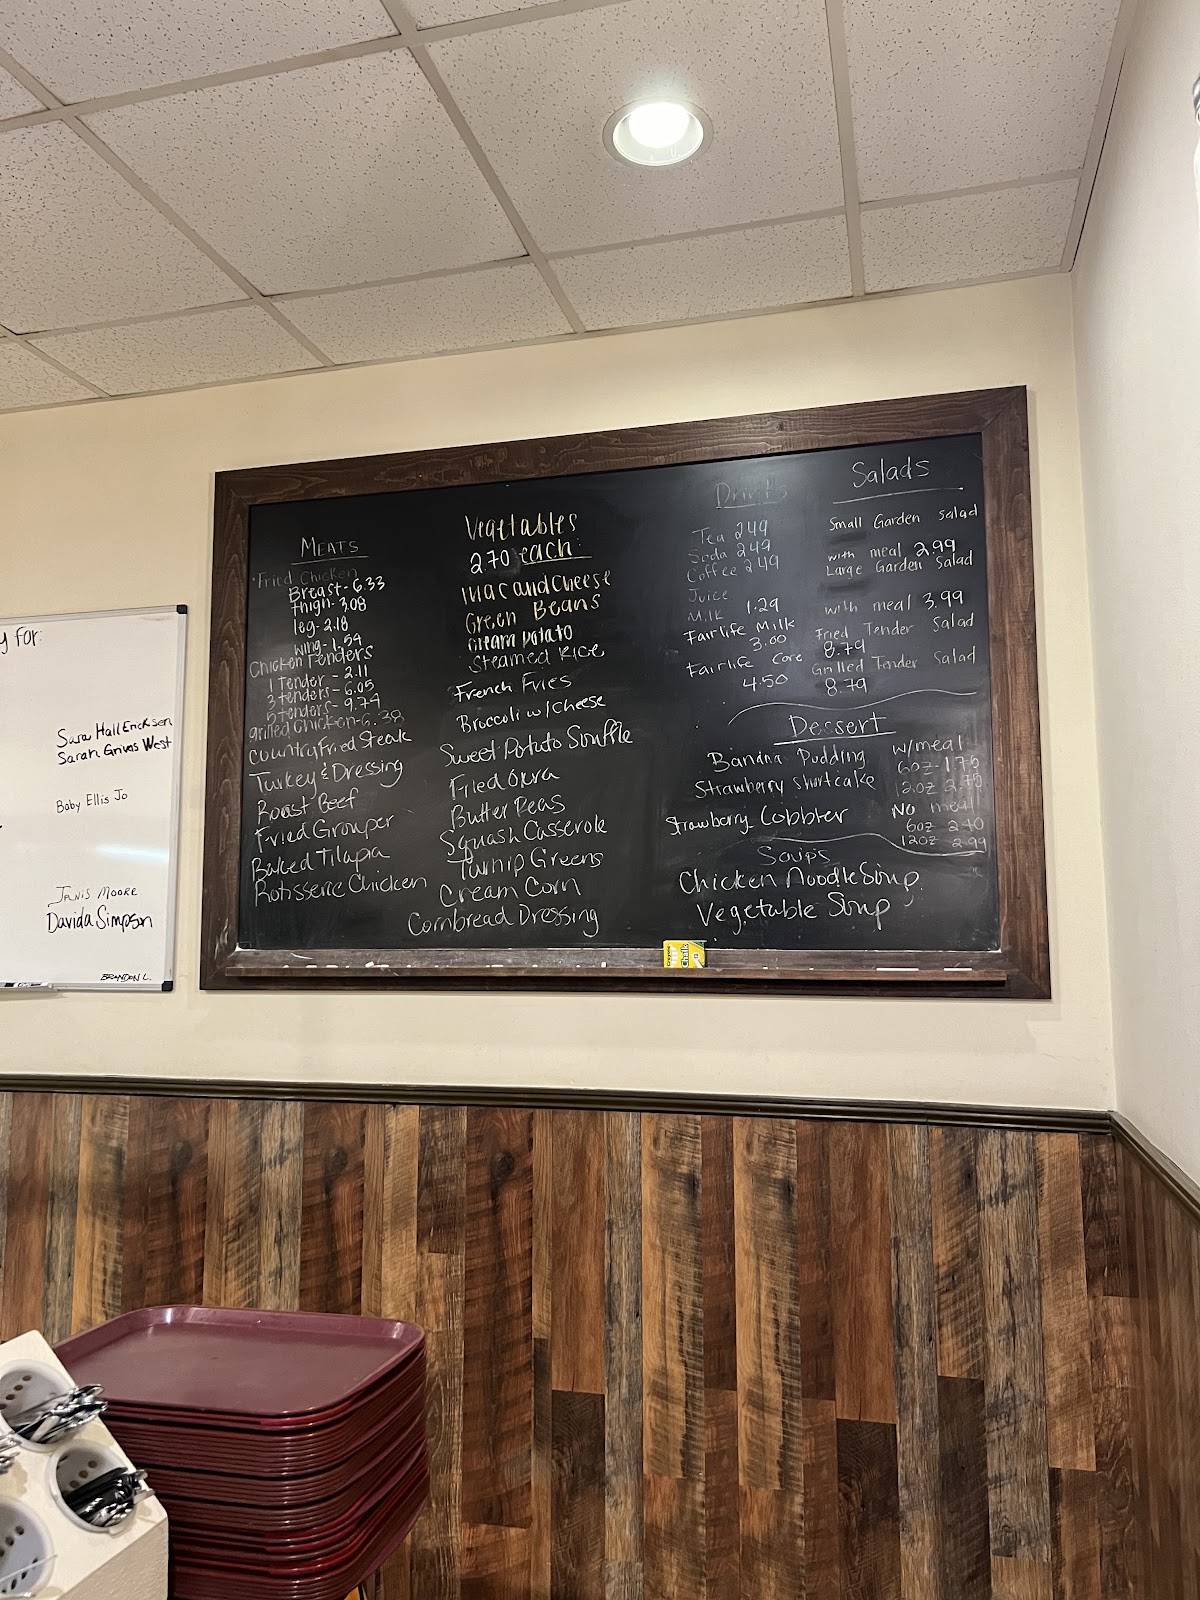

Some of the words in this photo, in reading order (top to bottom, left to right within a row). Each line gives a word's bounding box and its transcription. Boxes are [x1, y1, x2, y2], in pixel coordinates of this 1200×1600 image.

[851, 456, 931, 489] Salads
[464, 511, 579, 543] Vegetables
[829, 516, 863, 532] Small
[873, 511, 921, 530] Garden
[691, 526, 725, 544] Tea
[687, 546, 728, 564] Soda
[827, 549, 856, 563] with
[870, 542, 902, 559] meal
[913, 538, 956, 557] 2.99
[686, 561, 738, 583] Coffee
[825, 564, 863, 580] Large
[875, 555, 923, 574] Garden
[687, 587, 729, 603] Juice
[745, 597, 779, 615] 1.29
[824, 601, 858, 616] with
[872, 593, 912, 613] meal
[922, 589, 964, 611] 3.99
[465, 609, 517, 635] Green
[532, 593, 602, 622] Beans
[815, 626, 849, 641] Fried
[863, 619, 916, 637] Tender
[932, 612, 975, 634] Salad
[683, 622, 747, 645] Fairlife
[756, 616, 796, 633] Milk
[749, 634, 787, 652] 3.00
[250, 656, 303, 679] Chicken
[308, 644, 374, 669] Tenders
[558, 643, 606, 662] Rice
[823, 638, 866, 659] 8.79
[933, 645, 976, 666] Salad
[343, 663, 369, 680] 2.11
[686, 655, 754, 678] Fairlife
[344, 678, 376, 697] 6.05
[453, 679, 513, 704] French
[521, 671, 573, 694] Fries
[742, 673, 789, 692] 4.50
[824, 677, 868, 697] 8.79
[344, 692, 382, 714] 9.74
[95, 721, 121, 740] Hall
[456, 705, 521, 735] Broccoli
[788, 711, 888, 738] Dessert
[57, 747, 101, 766] Sarah
[142, 735, 173, 752] West
[359, 728, 413, 751] Steak
[440, 738, 498, 768] Sweet
[707, 750, 784, 773] Banana
[796, 744, 866, 770] Pudding
[249, 770, 318, 800] Turkey
[332, 760, 404, 788] Dressing
[449, 772, 506, 800] Fried
[508, 766, 561, 789] Okra
[694, 776, 785, 800] Strawberry
[56, 799, 81, 813] Baby
[86, 793, 110, 807] Ellis
[114, 788, 129, 802] Jo
[257, 794, 311, 825] Roast
[317, 787, 359, 814] Beef
[451, 800, 508, 830] Butter
[514, 794, 566, 818] Peas
[254, 821, 311, 854] Fried
[312, 814, 395, 840] Grouper
[665, 810, 754, 836] Strawberry
[439, 827, 521, 862] Squash
[523, 814, 608, 841] Casserole
[251, 851, 315, 882] Baked
[447, 851, 525, 881] Turnip
[530, 846, 604, 869] Greens
[757, 844, 831, 866] Soups
[348, 869, 428, 894] Chicken
[440, 883, 519, 908] Cream
[524, 875, 582, 897] Corn
[679, 867, 778, 895] Chicken
[786, 865, 858, 890] Noodle
[46, 906, 95, 934] Davida
[95, 904, 153, 934] Simpson
[407, 905, 515, 936] Cornbread
[518, 903, 600, 939] Dressing
[696, 898, 818, 936] Vegetable
[680, 943, 689, 968] Chalk
